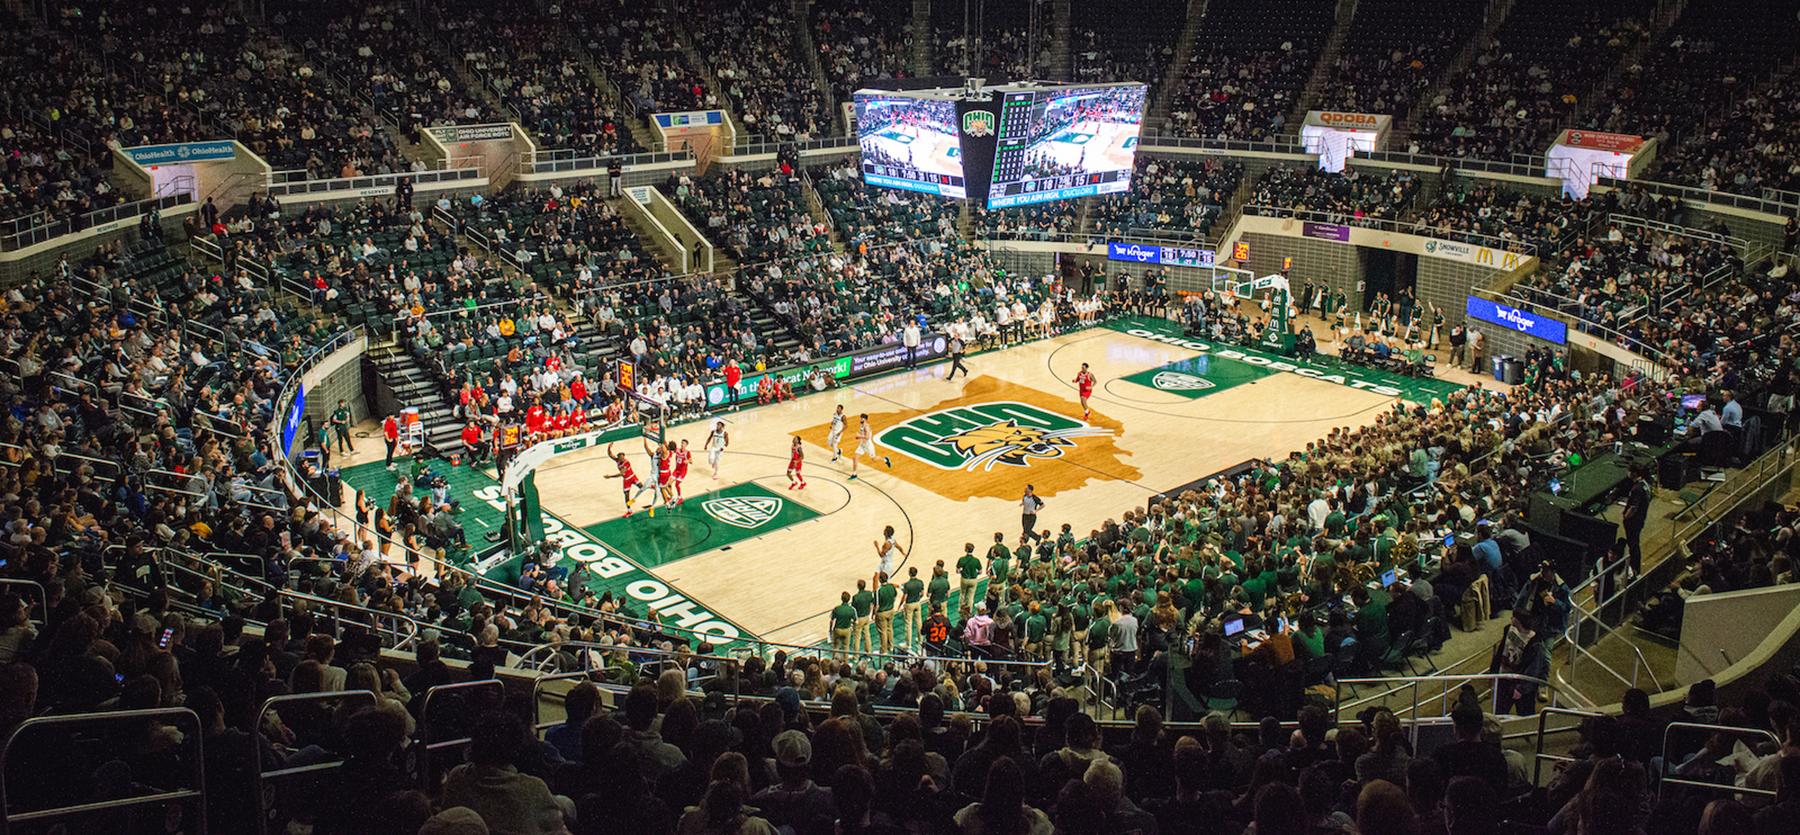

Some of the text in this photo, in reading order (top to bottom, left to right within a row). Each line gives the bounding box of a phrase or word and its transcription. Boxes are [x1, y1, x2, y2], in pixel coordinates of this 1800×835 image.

[963, 110, 995, 131] OHIO
[1320, 112, 1377, 125] QDOBA
[135, 149, 176, 160] OhioHealth
[191, 145, 234, 155] OhioHealth
[1074, 176, 1085, 186] 15
[992, 197, 1015, 207] WHERE
[1016, 195, 1031, 204] YOU
[1031, 193, 1043, 202] AIM
[1127, 245, 1155, 261] Kroger
[1439, 242, 1469, 254] SNOWVILLE
[1203, 255, 1212, 263] 15
[1507, 309, 1535, 331] Kroger
[854, 356, 865, 364] Your
[864, 361, 876, 369] Ohio
[876, 355, 902, 366] University
[1127, 329, 1211, 350] OHIO
[1216, 350, 1403, 396] BOBCATS
[626, 580, 739, 644] OHIO
